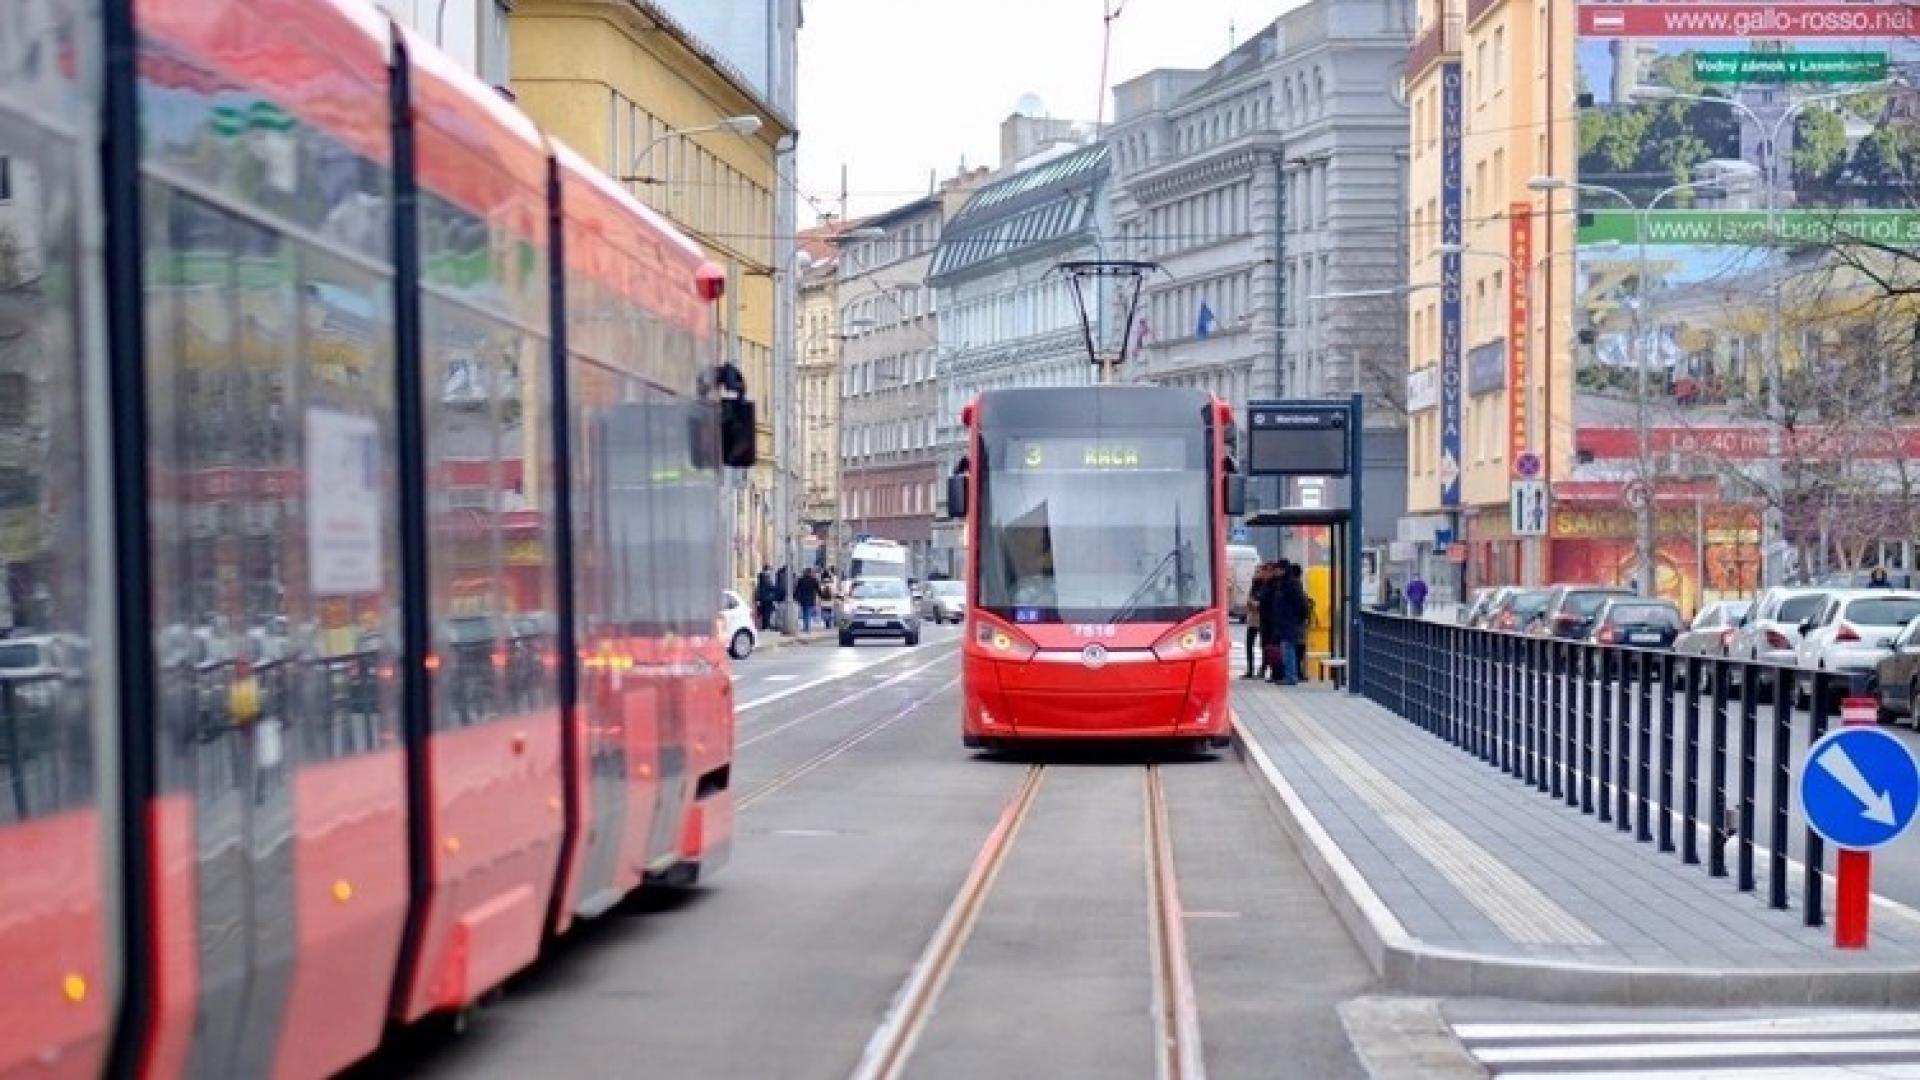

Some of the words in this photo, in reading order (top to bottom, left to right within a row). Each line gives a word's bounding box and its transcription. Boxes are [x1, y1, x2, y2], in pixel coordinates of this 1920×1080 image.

[1445, 73, 1460, 188] OLYMPIC
[1445, 203, 1460, 303] CAINO
[1445, 320, 1460, 436] EUROVEA
[1024, 443, 1041, 469] 3
